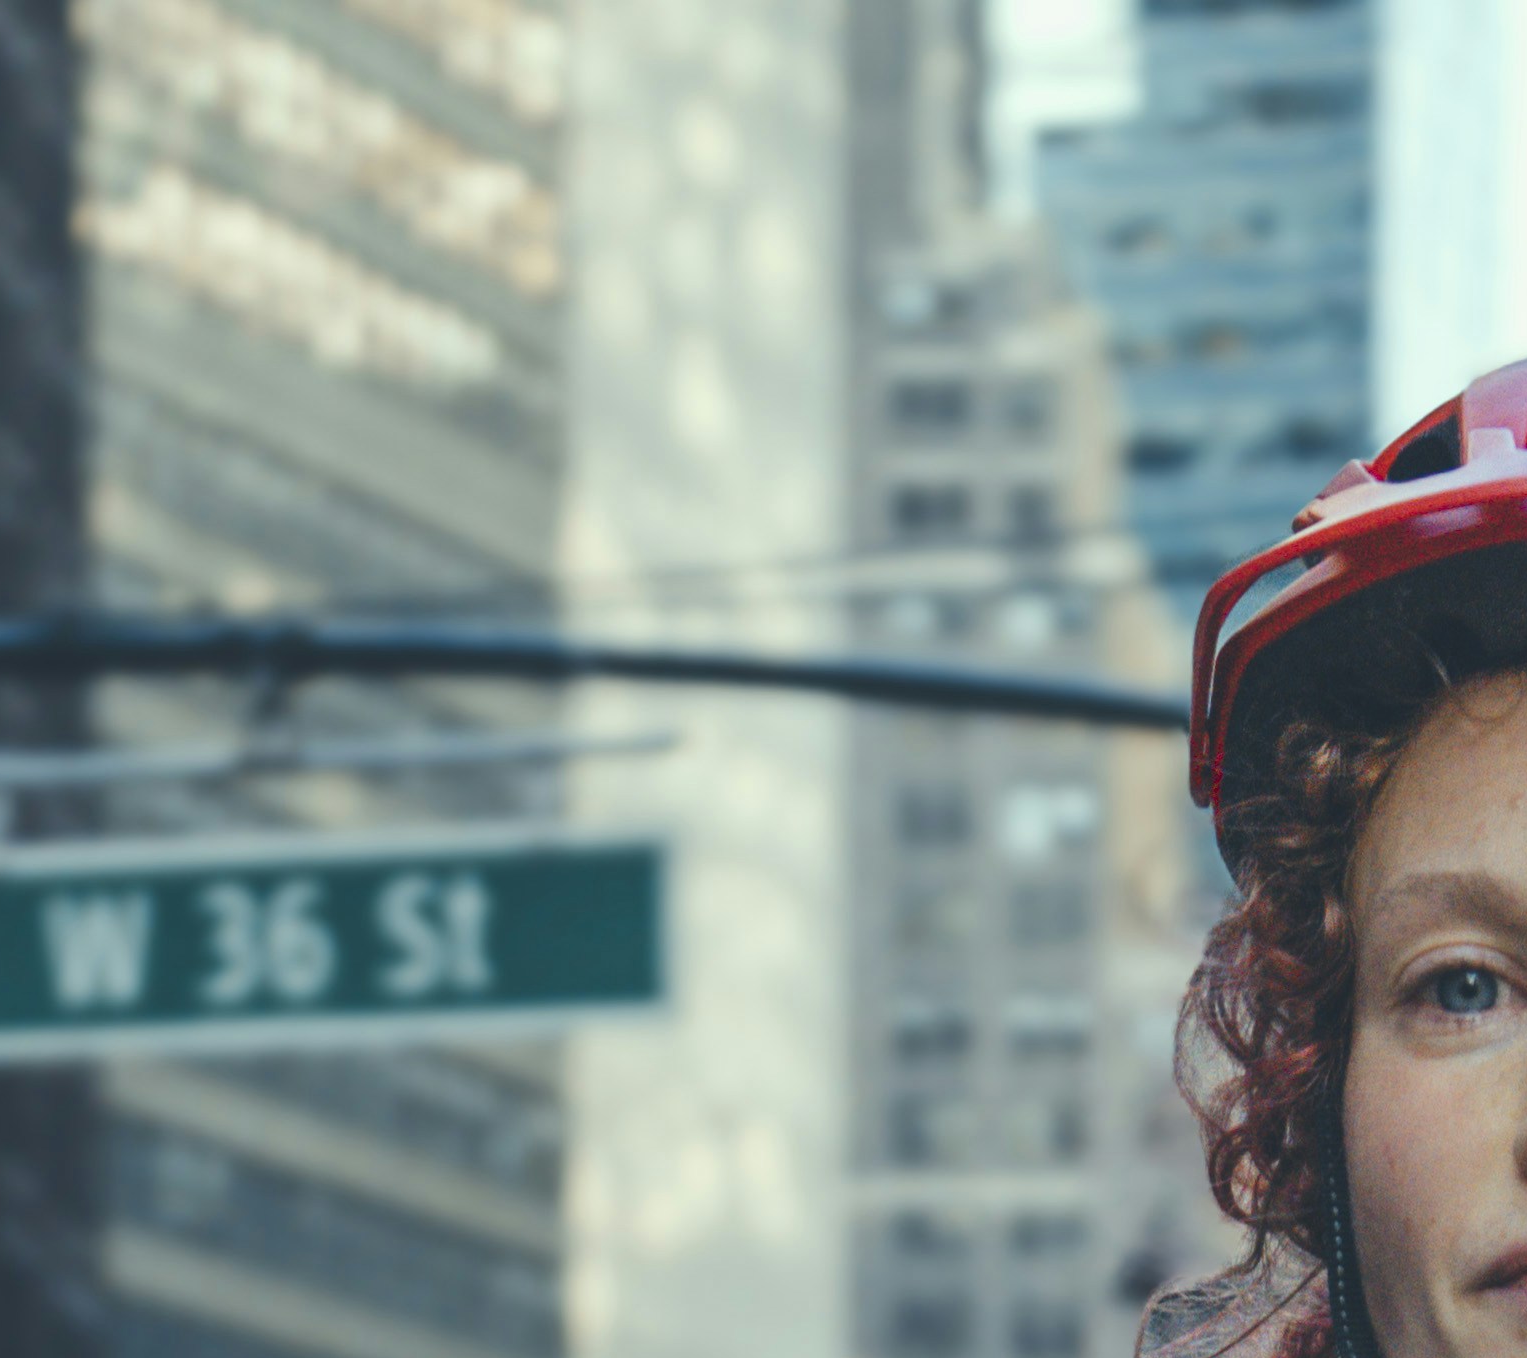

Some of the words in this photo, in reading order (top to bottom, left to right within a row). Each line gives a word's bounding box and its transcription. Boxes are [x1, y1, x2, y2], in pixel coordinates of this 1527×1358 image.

[39, 889, 157, 1011] W
[201, 879, 337, 1005] 36
[376, 870, 494, 996] St
